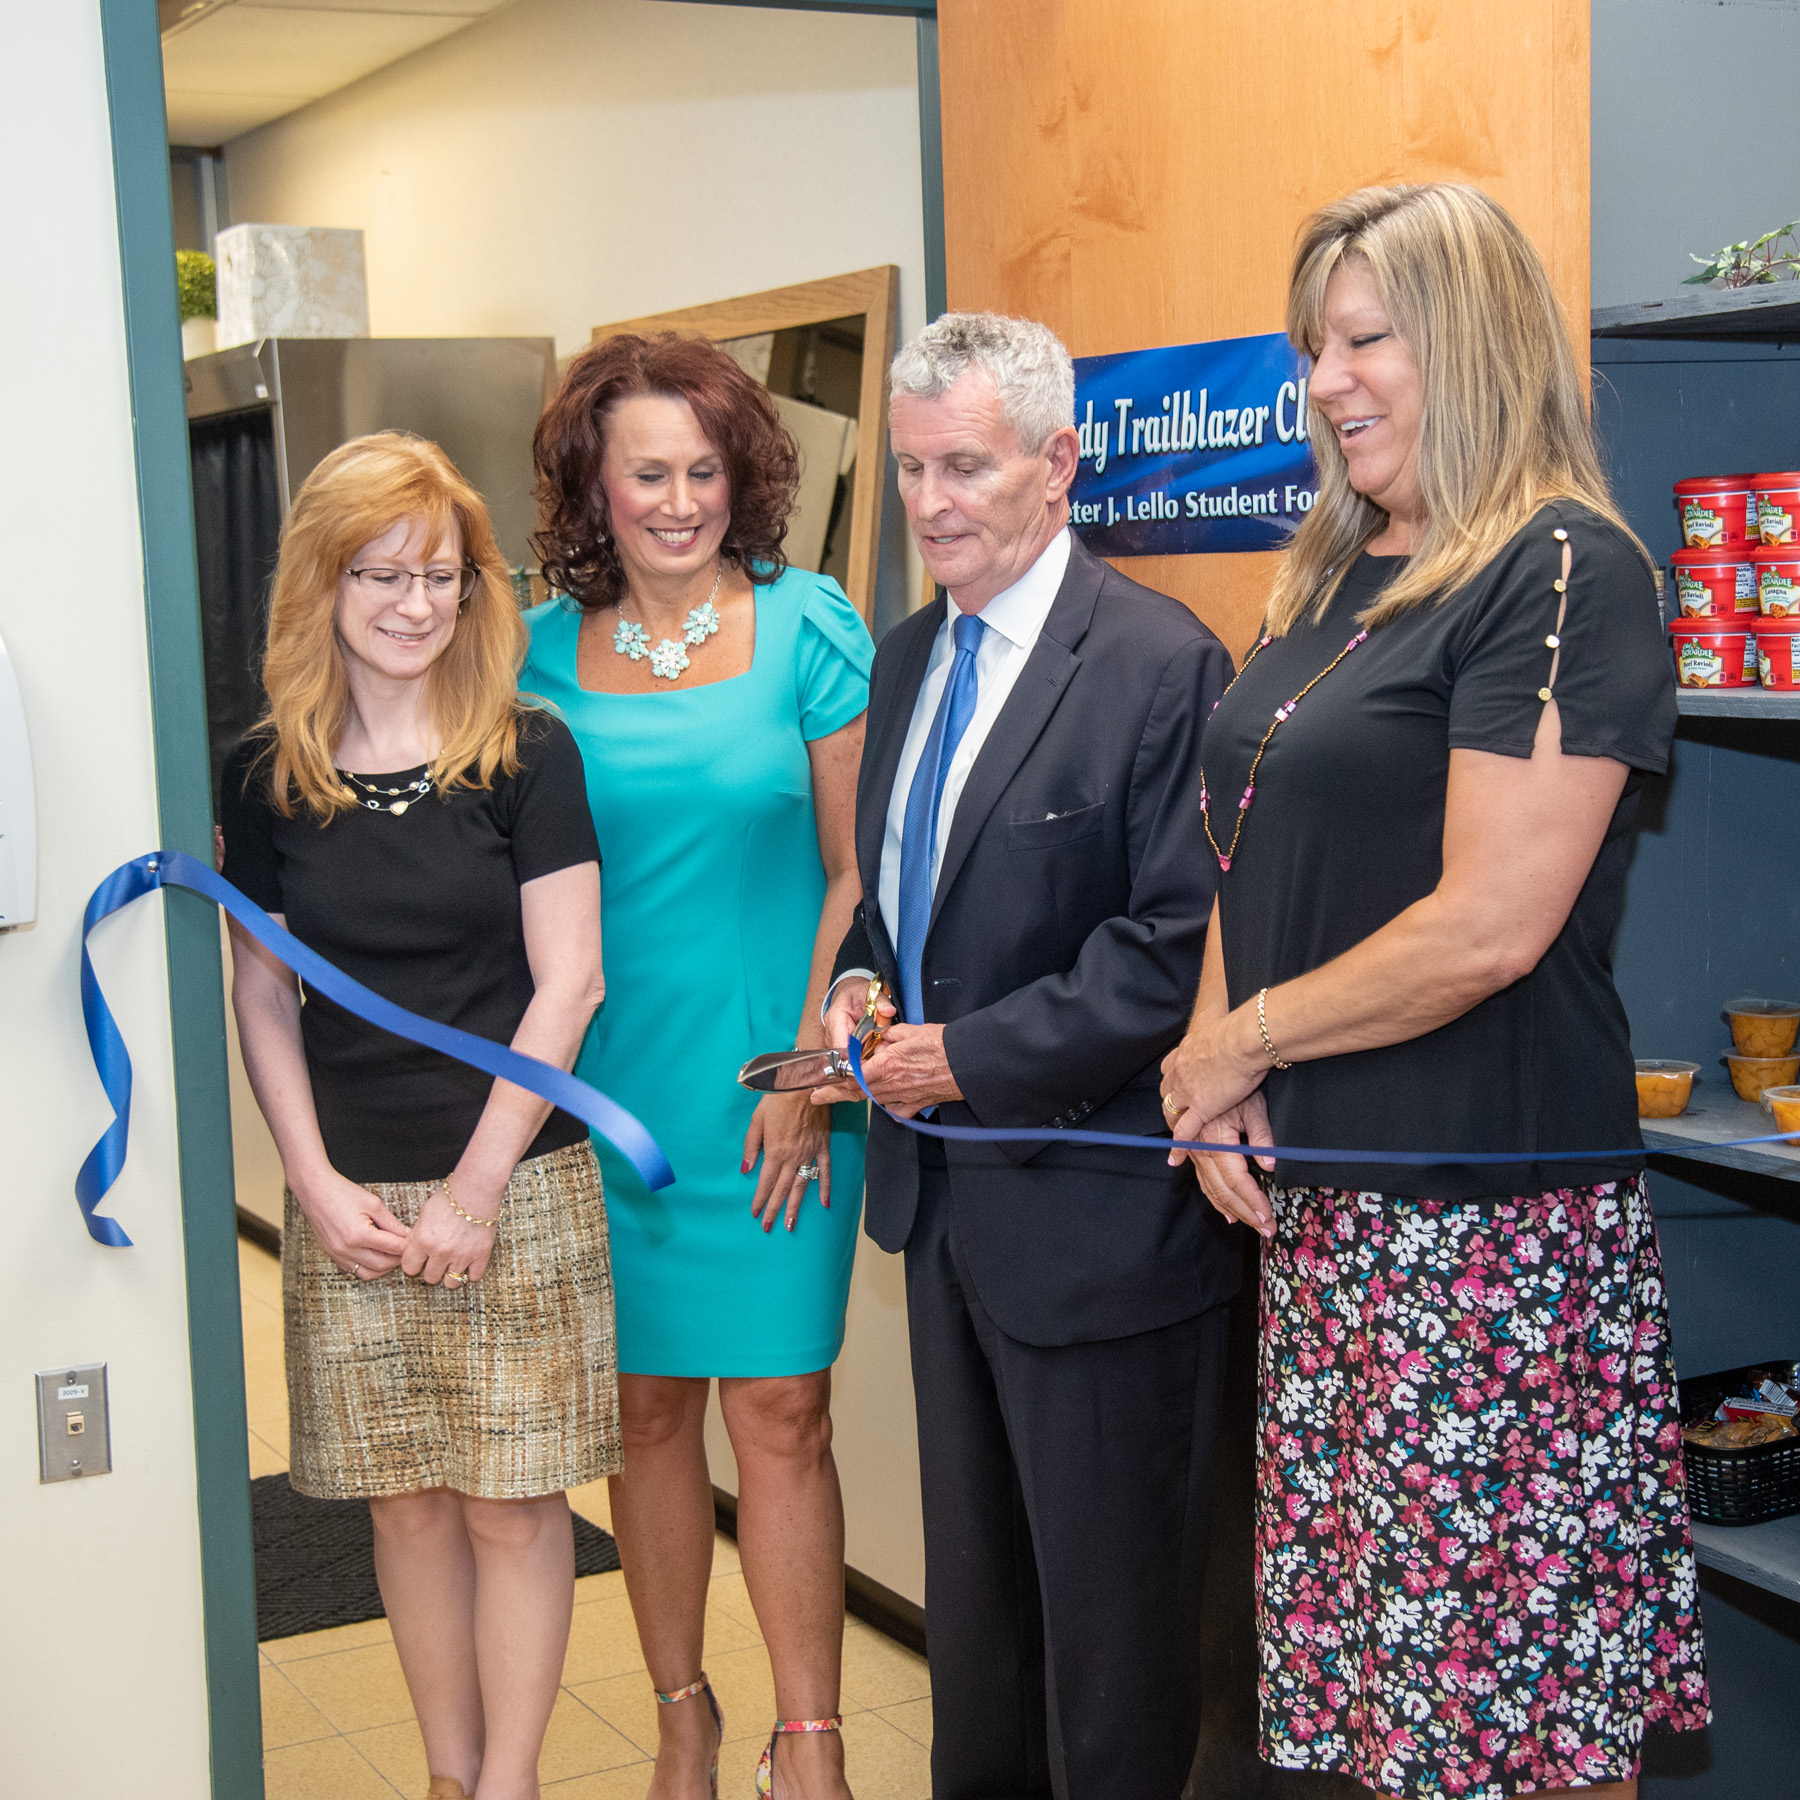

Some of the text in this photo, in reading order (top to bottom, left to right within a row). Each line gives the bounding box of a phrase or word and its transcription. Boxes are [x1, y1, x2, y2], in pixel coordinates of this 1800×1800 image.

[1114, 388, 1270, 456] Trailblazer
[1275, 377, 1311, 442] Cl
[1107, 497, 1121, 527] J.
[1127, 491, 1179, 521] Lello
[1185, 486, 1278, 518] Student
[1695, 521, 1715, 529] Ravioli
[1693, 660, 1714, 668] Ravioli
